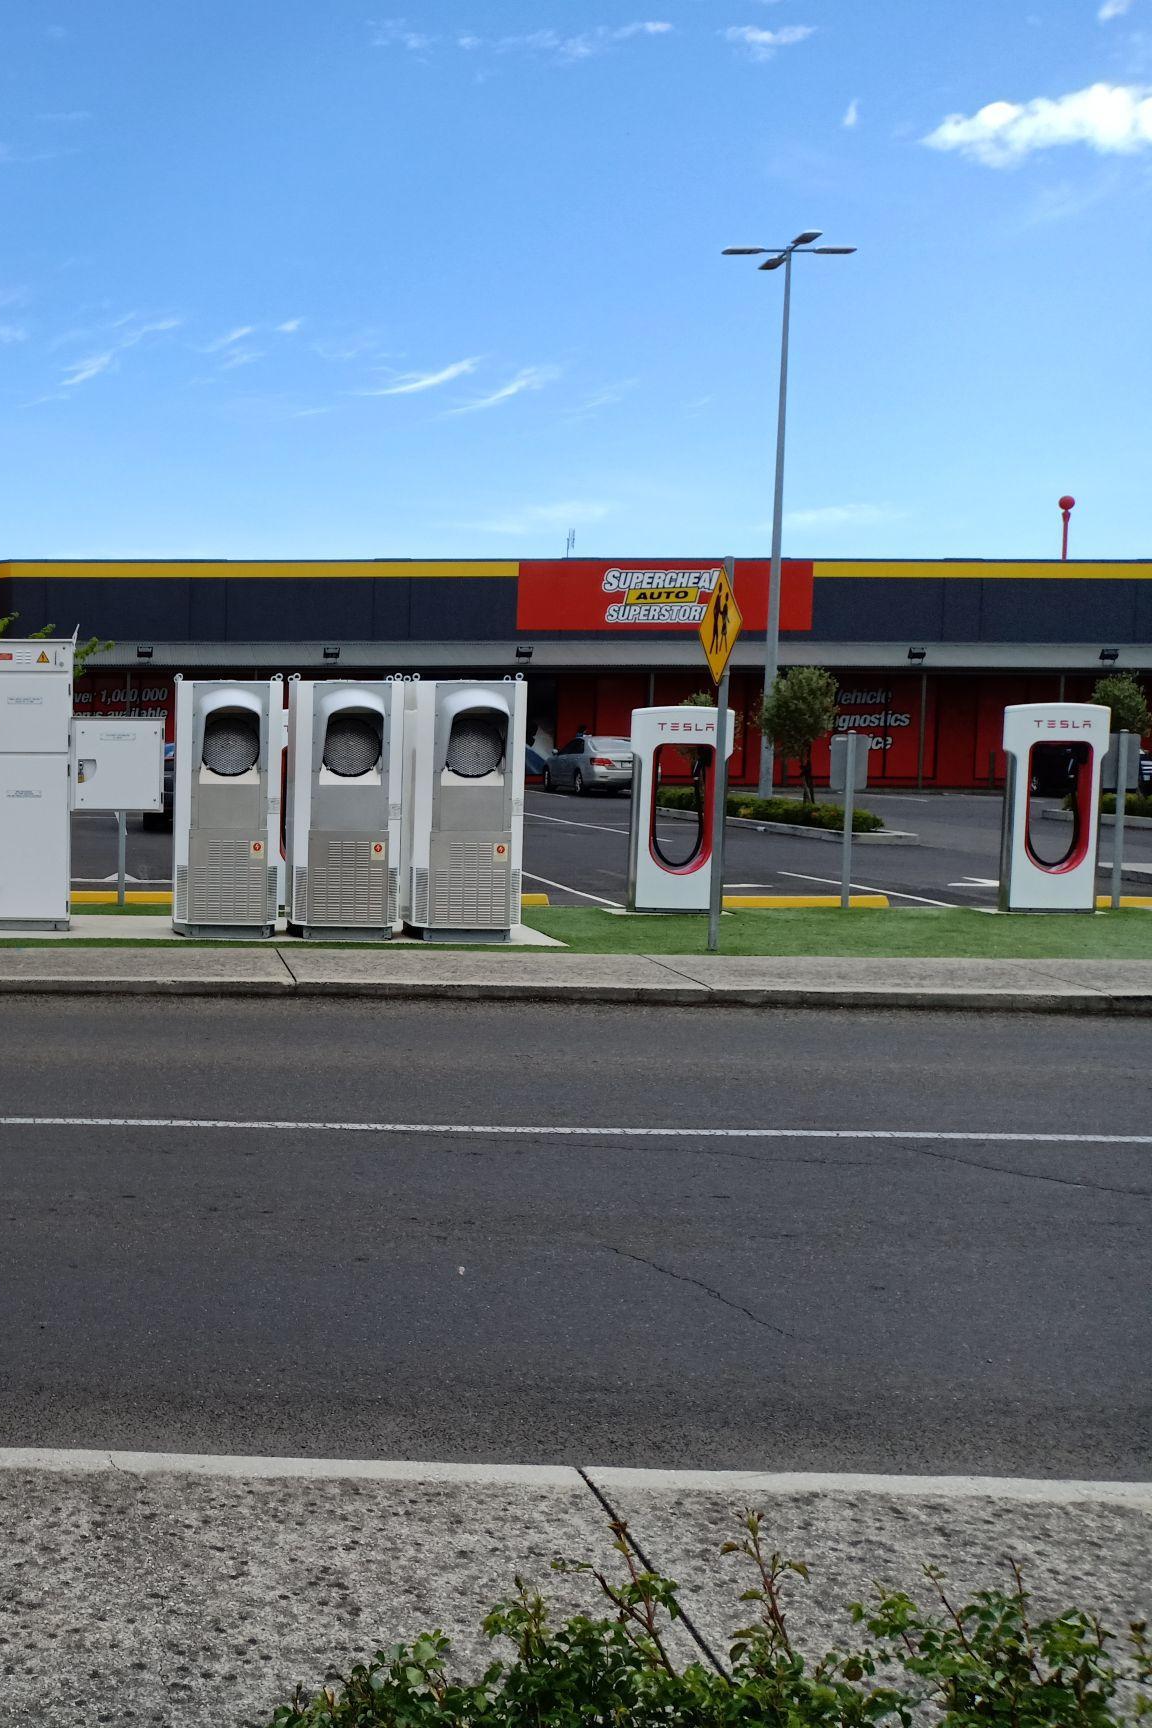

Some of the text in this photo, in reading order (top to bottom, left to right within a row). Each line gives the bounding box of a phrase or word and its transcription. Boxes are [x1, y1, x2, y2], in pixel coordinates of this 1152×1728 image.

[636, 590, 689, 601] AUTO
[657, 722, 715, 732] TESLA
[1033, 719, 1092, 729] TESLA
